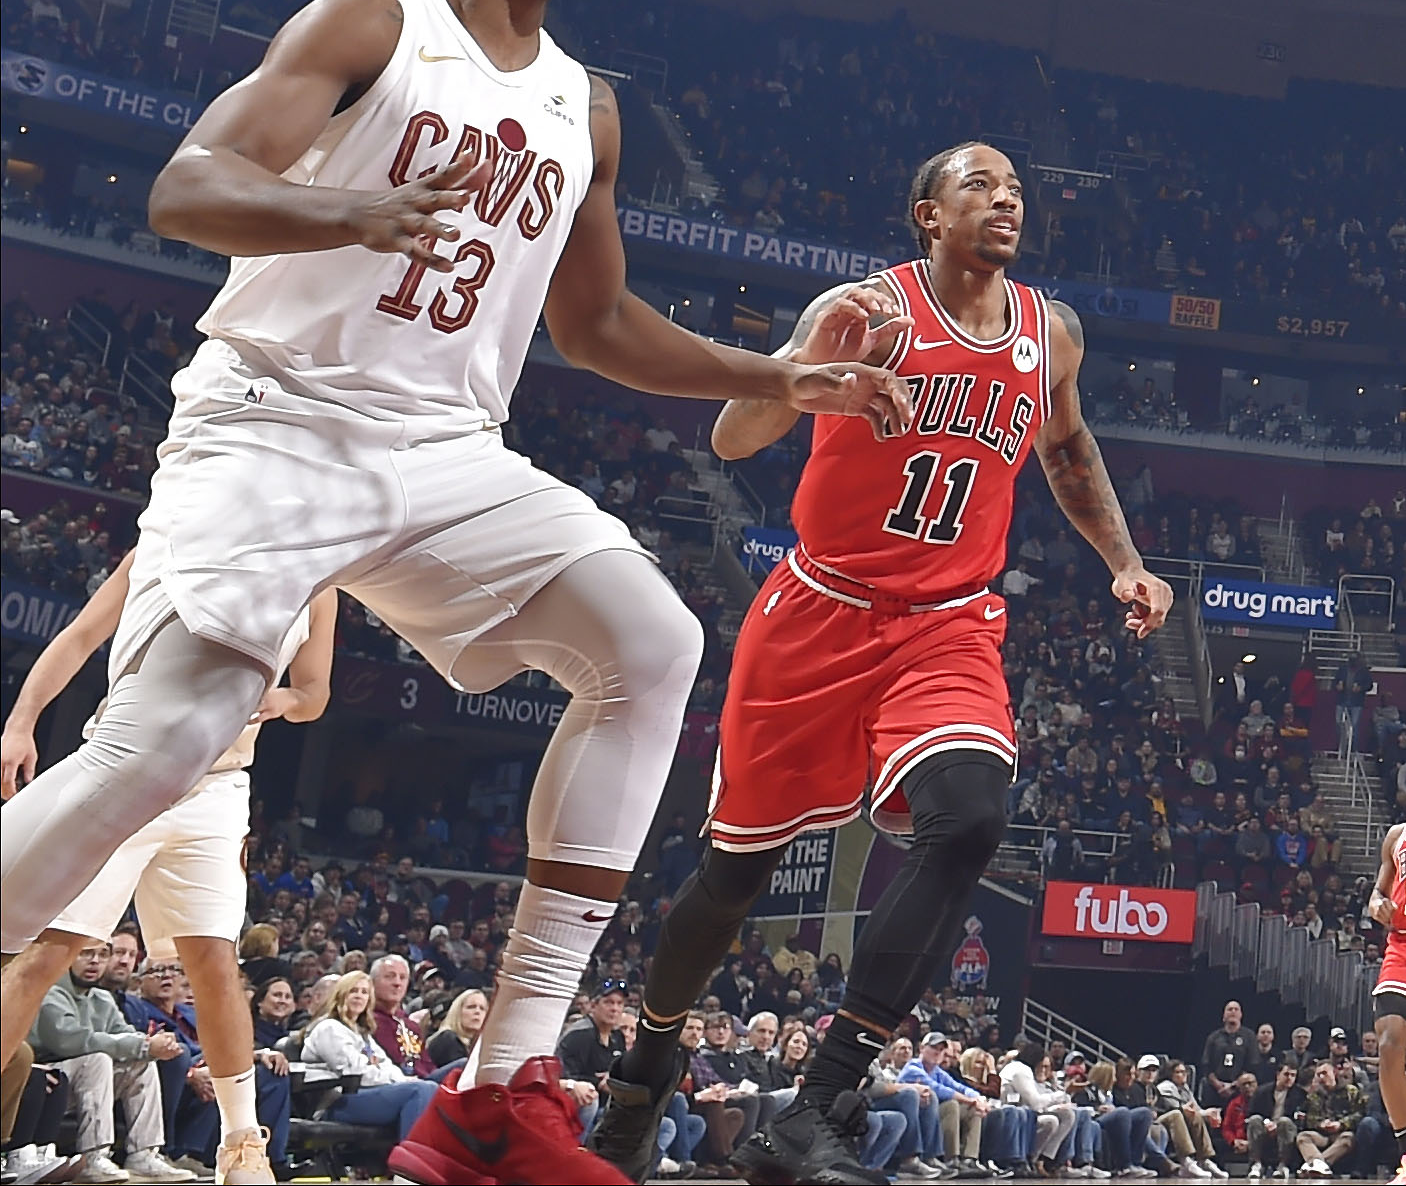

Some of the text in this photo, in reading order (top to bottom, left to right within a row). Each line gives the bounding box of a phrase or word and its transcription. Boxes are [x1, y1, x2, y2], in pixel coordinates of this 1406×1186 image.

[55, 75, 96, 100] OF
[102, 85, 157, 118] THE
[616, 208, 888, 278] BERFIT PARTNER
[376, 233, 495, 334] 13
[1175, 314, 1214, 326] RAFFLE
[1176, 298, 1215, 314] 50/50
[1277, 316, 1349, 338] $2,957
[882, 450, 979, 545] 11
[743, 538, 784, 562] drug
[1205, 583, 1335, 618] drug mart
[401, 679, 418, 709] 3
[454, 691, 565, 727] TURNOVE
[796, 839, 828, 863] THE
[770, 867, 825, 895] PAINT
[1074, 886, 1168, 936] fubo
